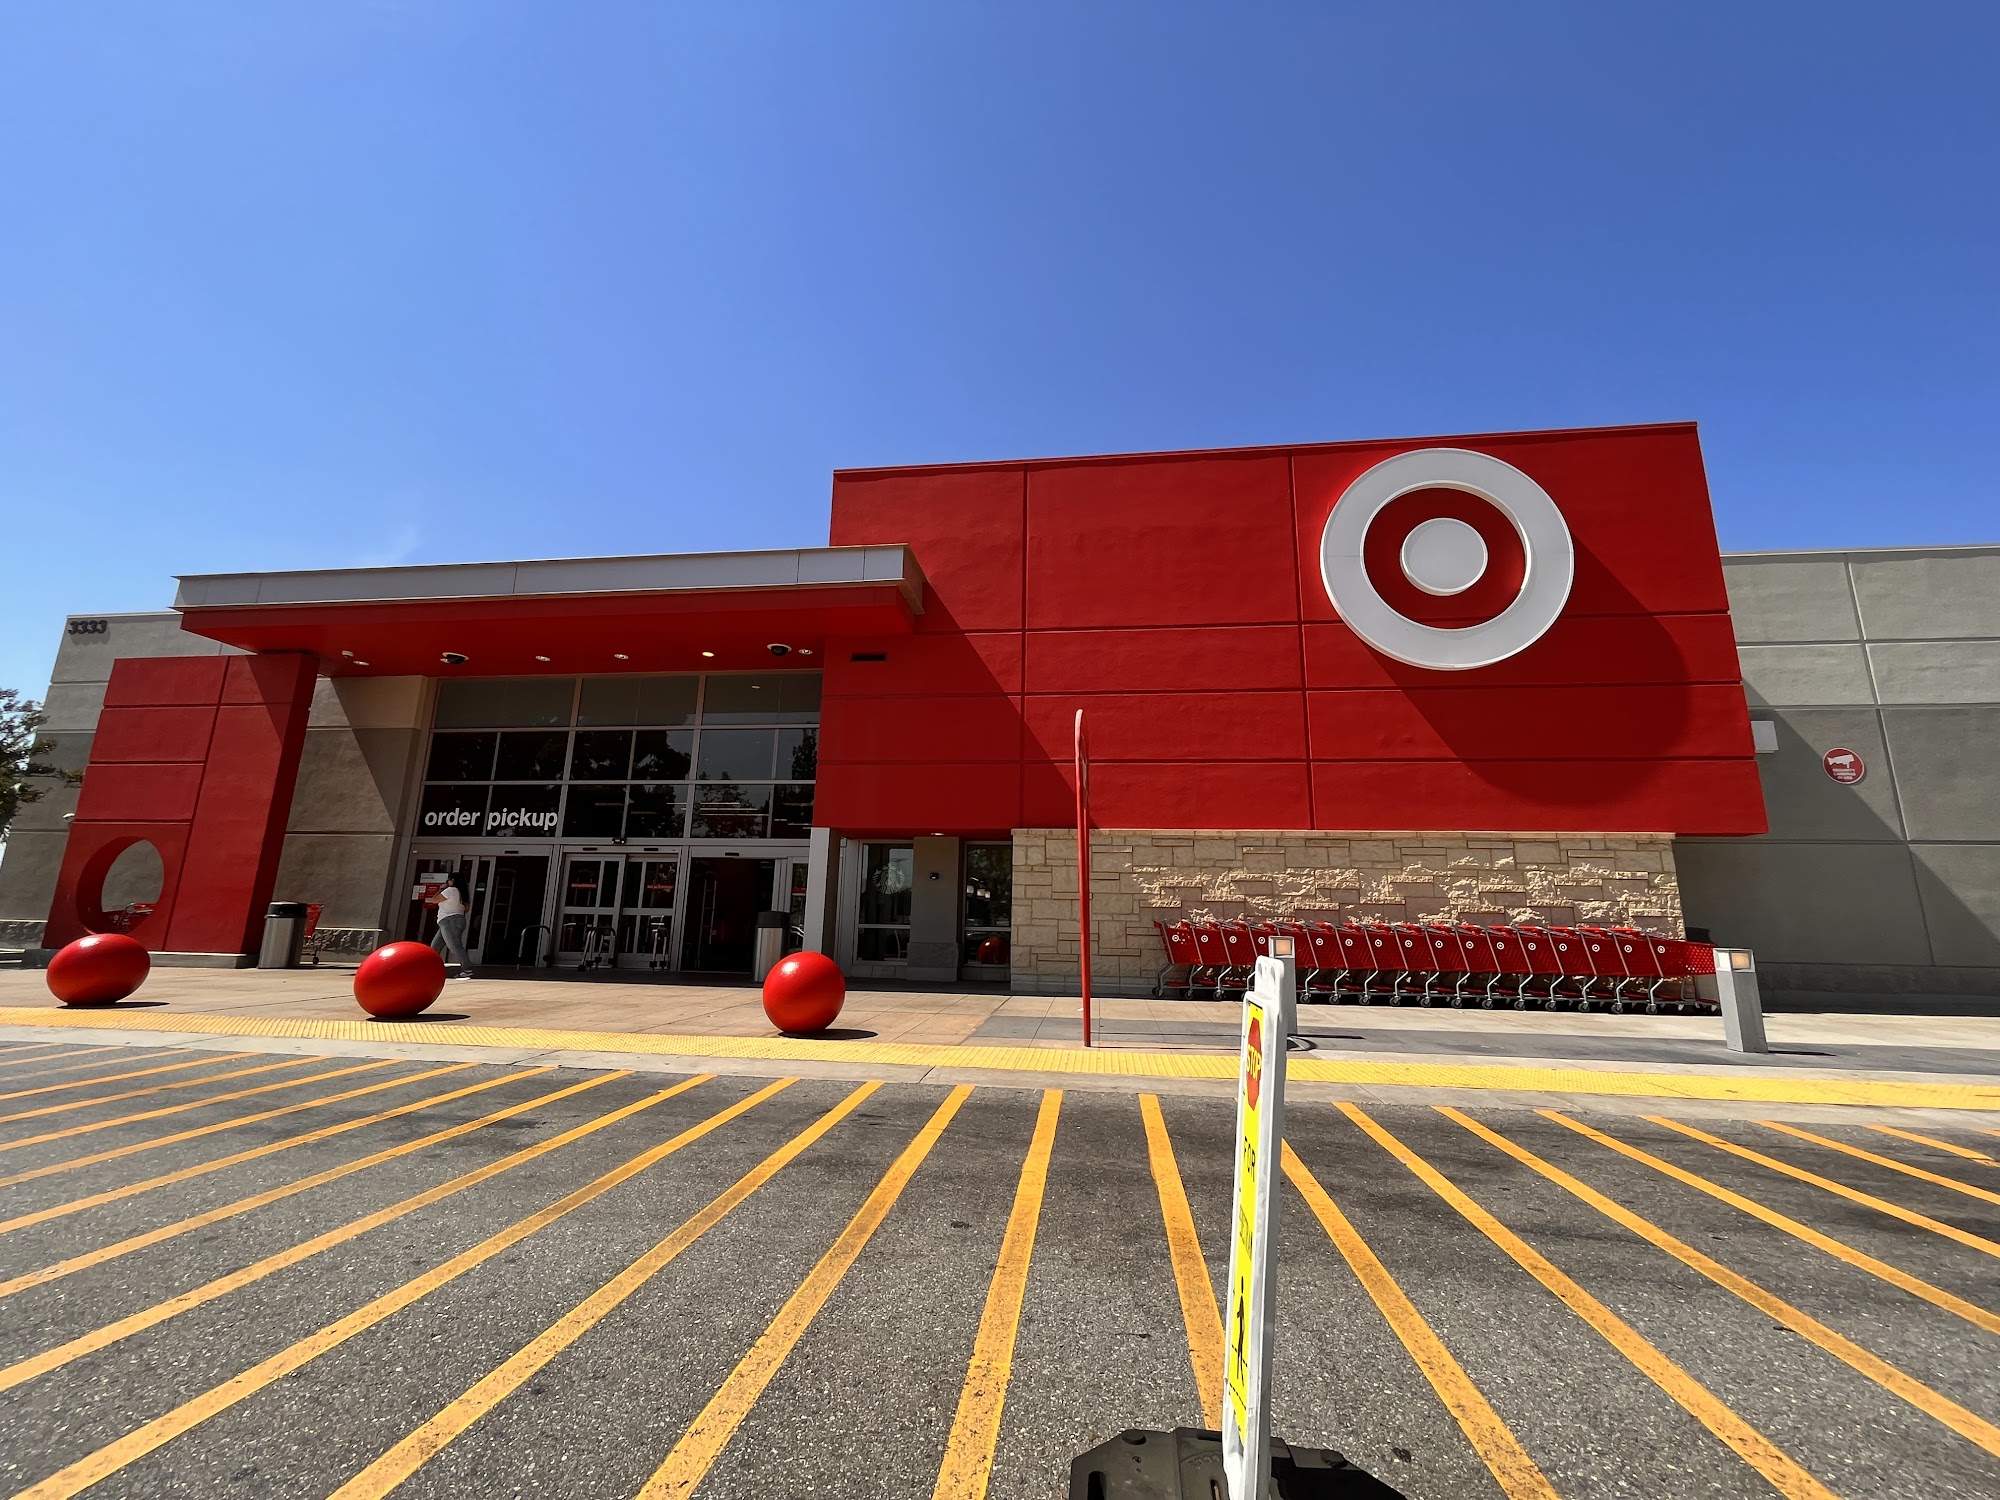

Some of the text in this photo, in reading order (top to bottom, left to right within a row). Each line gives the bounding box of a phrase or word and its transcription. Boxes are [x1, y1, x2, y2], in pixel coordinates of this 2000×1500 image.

[68, 620, 108, 635] 3333
[425, 808, 558, 831] order pickup
[1246, 1043, 1263, 1081] STOP
[1244, 1136, 1256, 1182] FOR
